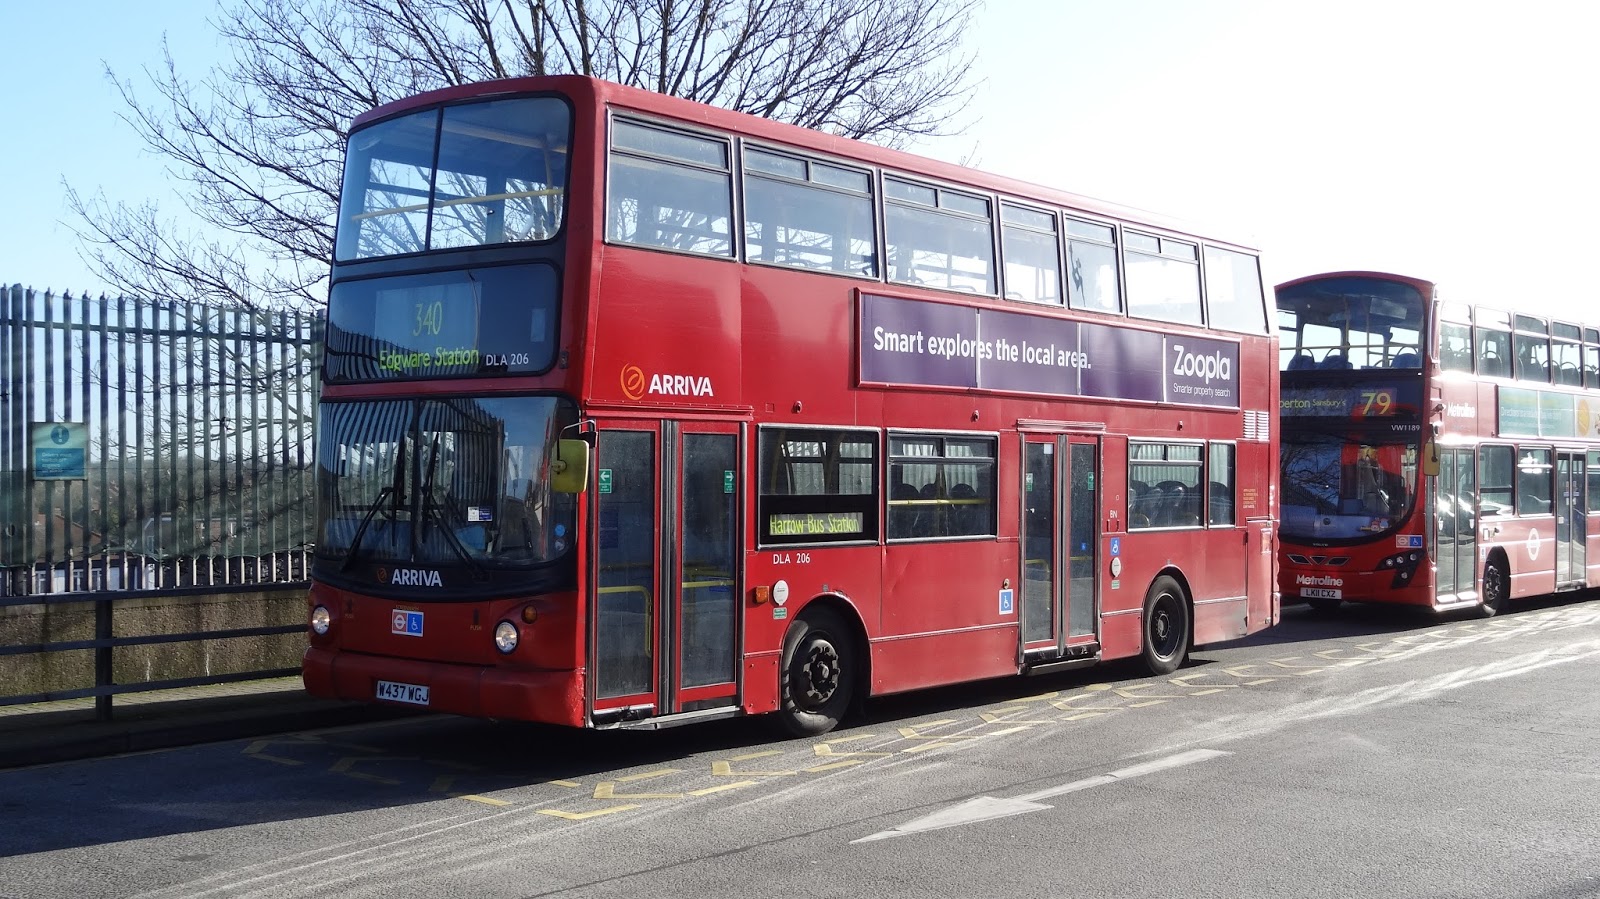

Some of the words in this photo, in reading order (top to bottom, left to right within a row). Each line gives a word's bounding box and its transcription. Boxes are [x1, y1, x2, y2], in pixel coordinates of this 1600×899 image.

[413, 301, 443, 337] 340
[873, 326, 924, 353] Smart
[927, 335, 992, 360] explores
[995, 339, 1019, 363] the
[1021, 344, 1055, 366] local
[1057, 349, 1092, 370] area.
[379, 350, 431, 372] Edgware
[435, 347, 479, 367] Station
[485, 354, 508, 366] DLA
[510, 352, 529, 365] 206
[1173, 344, 1231, 385] Zoopla
[648, 373, 714, 397] ARRIVA
[1174, 382, 1193, 394] Smarter
[1193, 386, 1214, 398] property
[1214, 388, 1231, 398] search
[1360, 392, 1392, 415] 79
[1446, 401, 1476, 419] Metroline
[1390, 424, 1421, 432] VW1189
[769, 513, 804, 534] Harrow
[807, 514, 825, 534] Bus
[827, 513, 860, 533] Station
[772, 553, 791, 564] DLA
[795, 552, 811, 564] 206
[391, 568, 443, 588] ARRIVA
[1296, 574, 1344, 587] Metroline
[1321, 589, 1336, 598] CXZ
[378, 682, 406, 698] W437
[407, 684, 429, 702] WGJ
